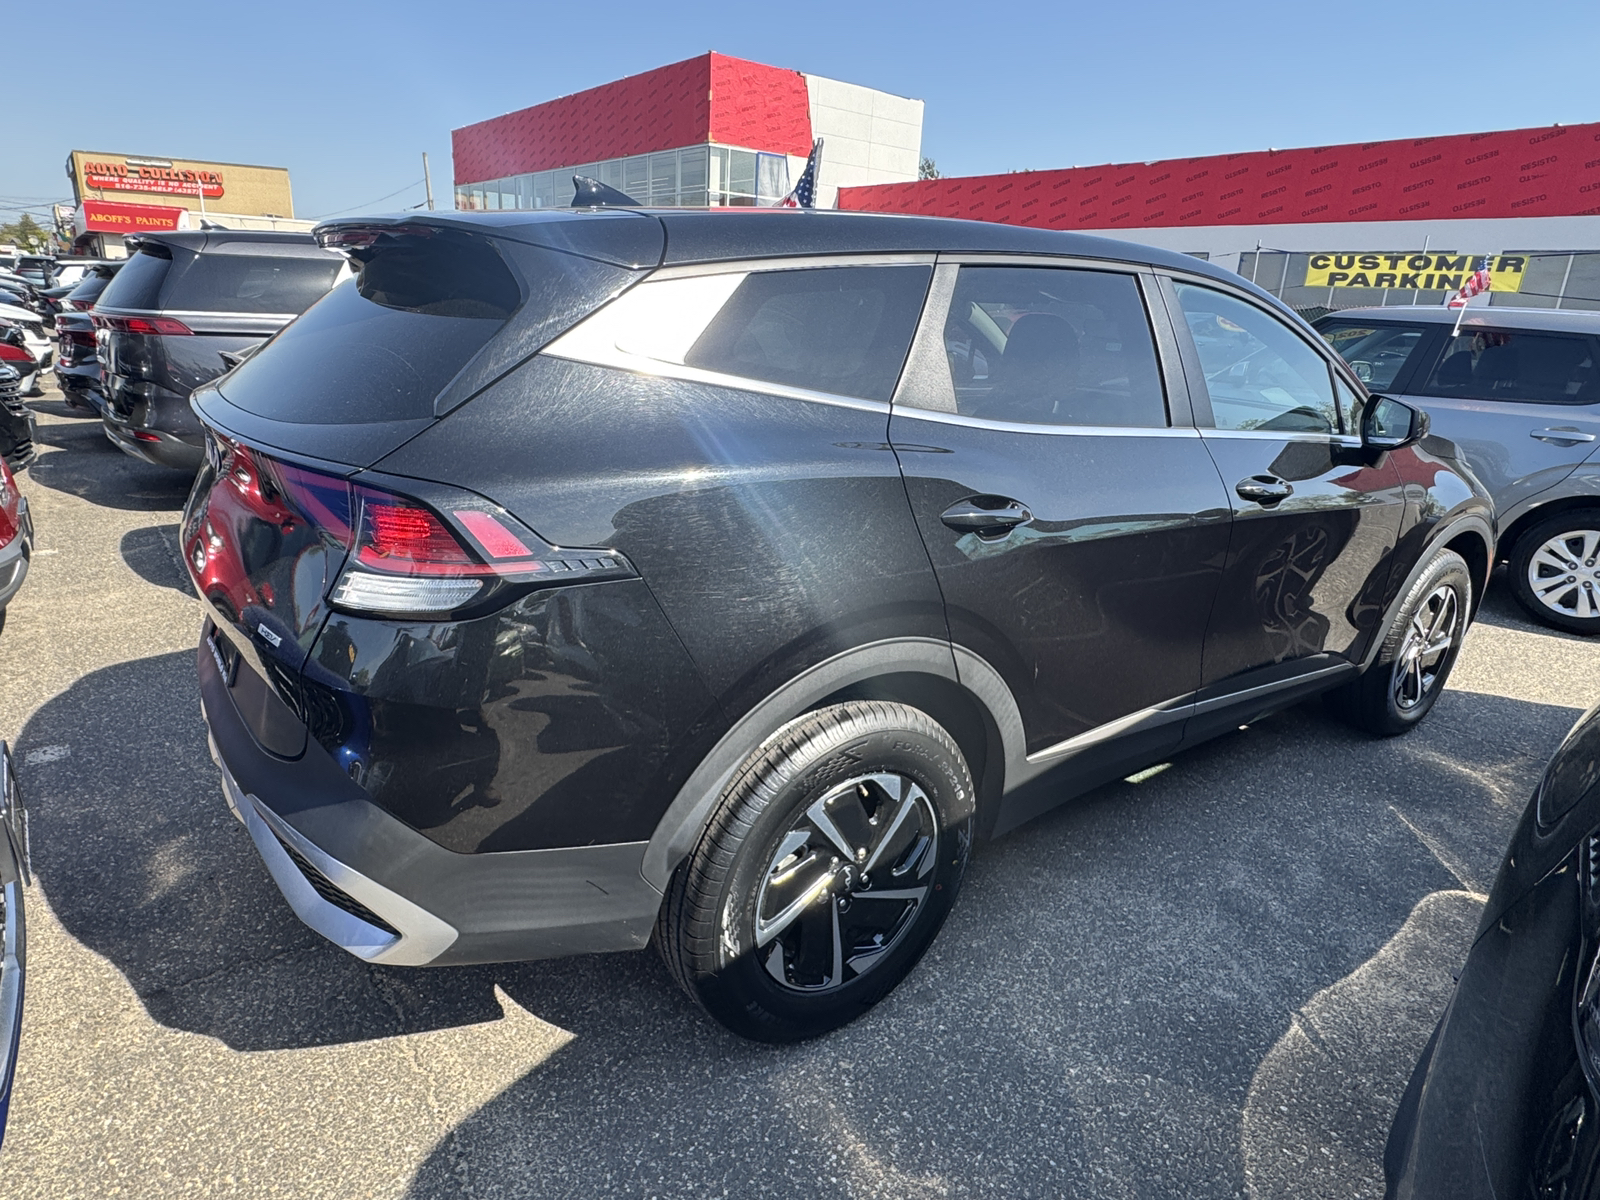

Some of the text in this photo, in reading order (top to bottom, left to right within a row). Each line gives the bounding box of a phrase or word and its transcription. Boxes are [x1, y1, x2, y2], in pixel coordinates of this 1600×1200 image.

[1358, 157, 1388, 172] RESISTO
[1410, 154, 1442, 169] RESISTO
[1465, 150, 1499, 165] RESISTO
[1521, 155, 1558, 171] RESISTO
[85, 162, 222, 183] AUTO COLLISION
[92, 175, 119, 183] WHERE
[1352, 181, 1382, 195] RESISTO
[1403, 178, 1434, 193] RESISTO
[1457, 176, 1491, 190] RESISTO
[1399, 201, 1430, 214] RESISTO
[1452, 198, 1486, 212] RESISTO
[1511, 194, 1547, 209] RESISTO
[90, 213, 174, 227] ABOFF'S PAINTS
[1310, 255, 1525, 273] CUSTOMER
[1327, 272, 1490, 290] PARKIN
